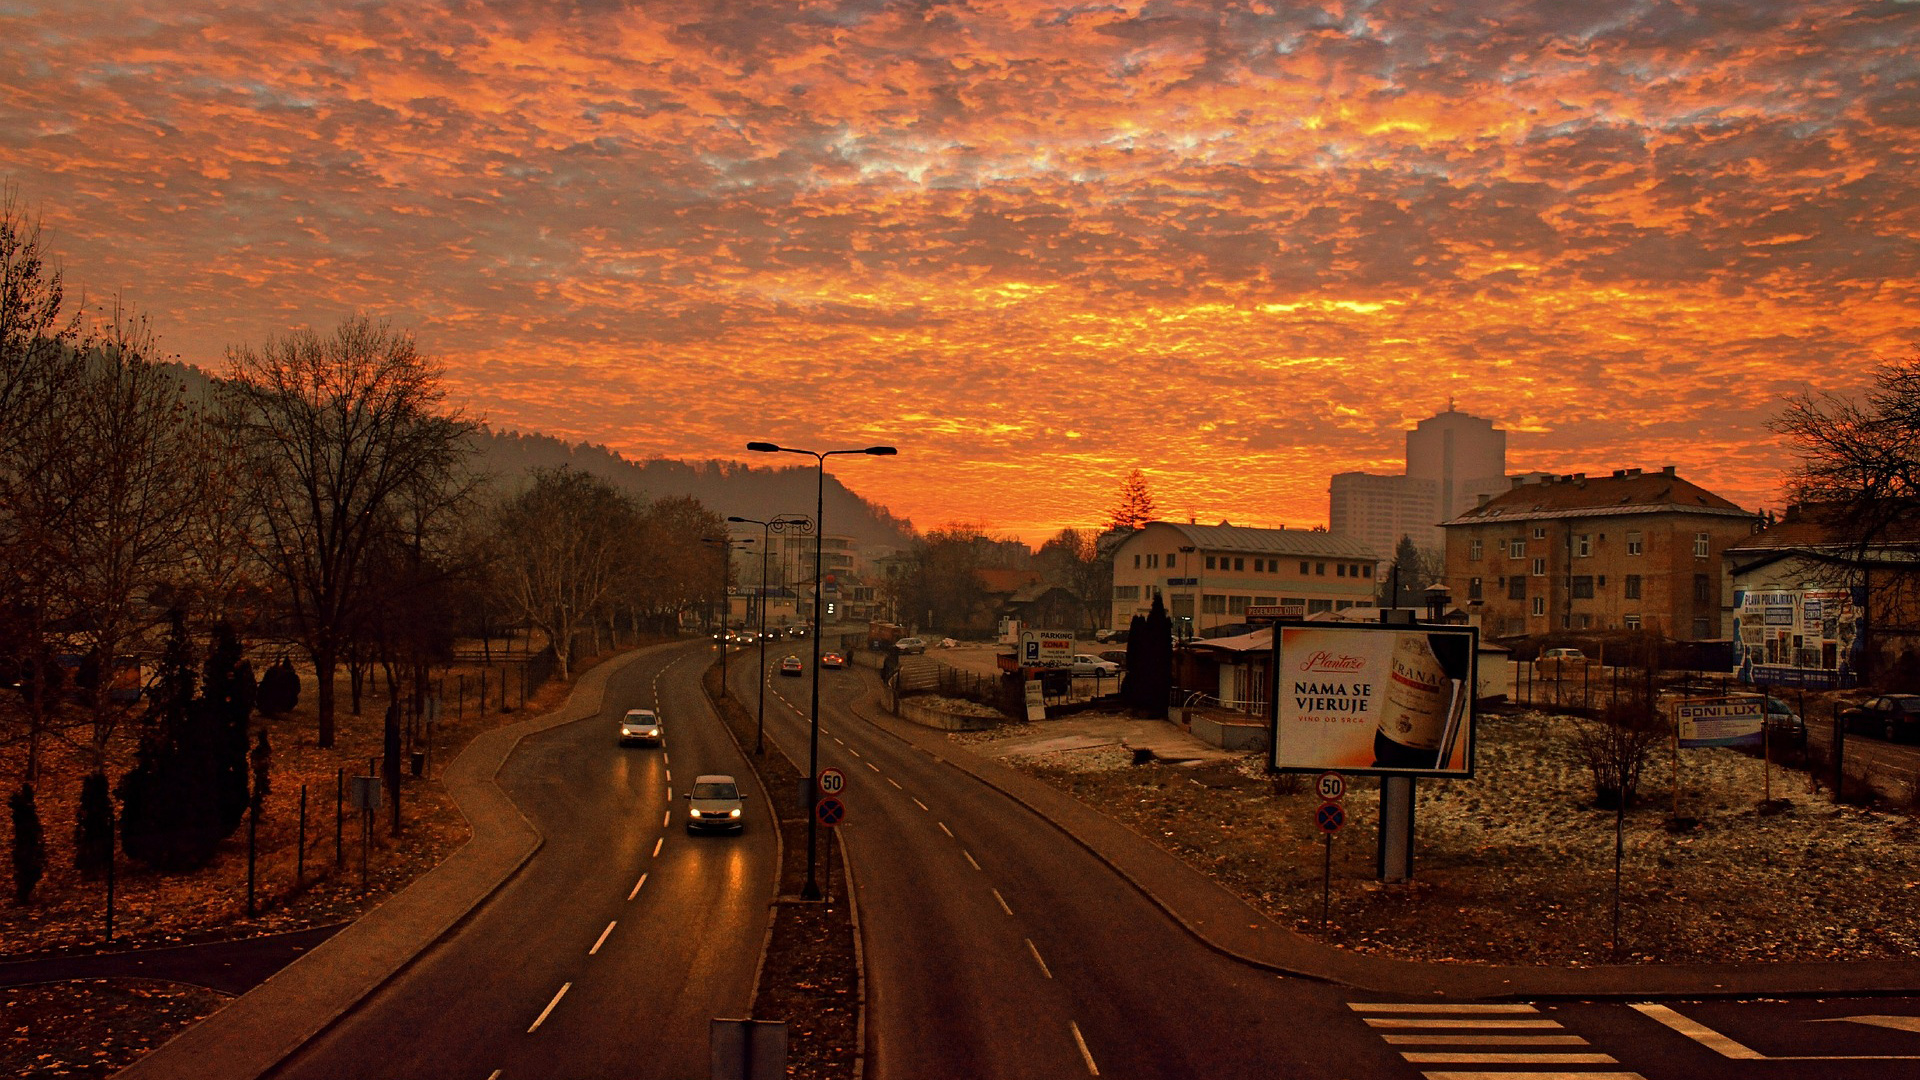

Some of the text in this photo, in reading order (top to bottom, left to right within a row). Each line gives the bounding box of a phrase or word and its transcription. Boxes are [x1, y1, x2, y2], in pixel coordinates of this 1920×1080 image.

[1284, 606, 1303, 615] DINO
[1040, 632, 1073, 640] PARKING
[1029, 643, 1036, 652] P
[1294, 681, 1371, 697] NAMA SE
[1296, 697, 1368, 714] VJERUJE
[1681, 705, 1757, 717] SONI LUX
[823, 775, 841, 790] 50
[1322, 779, 1340, 795] 50
